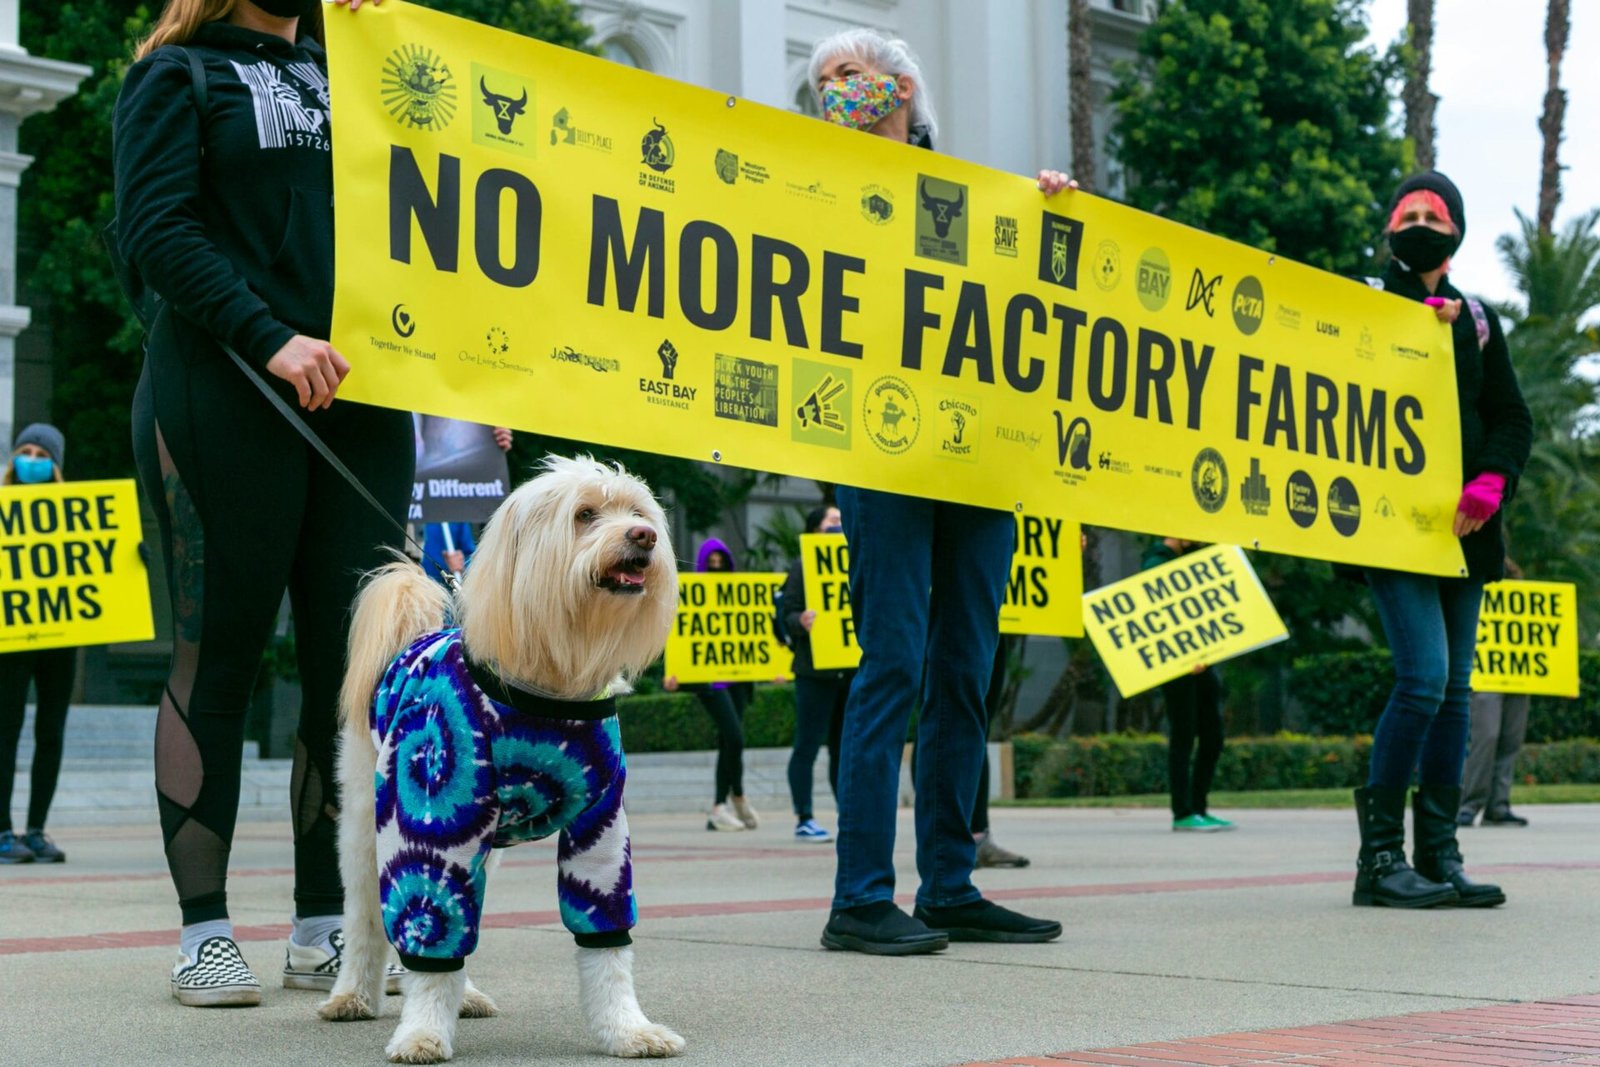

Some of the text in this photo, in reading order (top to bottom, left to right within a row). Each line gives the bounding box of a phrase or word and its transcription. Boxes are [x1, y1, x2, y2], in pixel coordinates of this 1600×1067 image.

[286, 133, 330, 152] 15726
[639, 172, 675, 187] IN DEFENSE
[639, 179, 675, 194] OF ANIMALS
[995, 215, 1018, 230] ANIMAL
[994, 226, 1018, 249] SAVE
[1138, 267, 1170, 298] BAY
[389, 144, 1426, 476] NO MORE FACTORY FARMS
[1316, 320, 1340, 337] LUSH
[370, 336, 436, 361] Together We Stand
[458, 350, 476, 363] One
[498, 358, 534, 377] Sanctuary
[715, 359, 774, 380] BLACK YOUTH
[639, 378, 697, 401] EAST BAY
[734, 376, 751, 390] THE
[646, 395, 689, 410] RESISTANCE
[715, 387, 754, 405] PEOPLE'S
[715, 401, 765, 420] LIBERATION
[938, 399, 978, 417] Chicano
[941, 439, 971, 455] Power
[428, 478, 504, 498] Different
[0, 495, 119, 536] MORE
[1014, 515, 1062, 559] RY
[0, 539, 116, 581] TORY
[678, 583, 706, 606] NO
[1091, 553, 1233, 625] NO MORE
[1108, 580, 1241, 650] FACTORY
[1485, 590, 1563, 618] MORE
[1137, 612, 1245, 670] FARMS
[691, 641, 770, 666] FARMS
